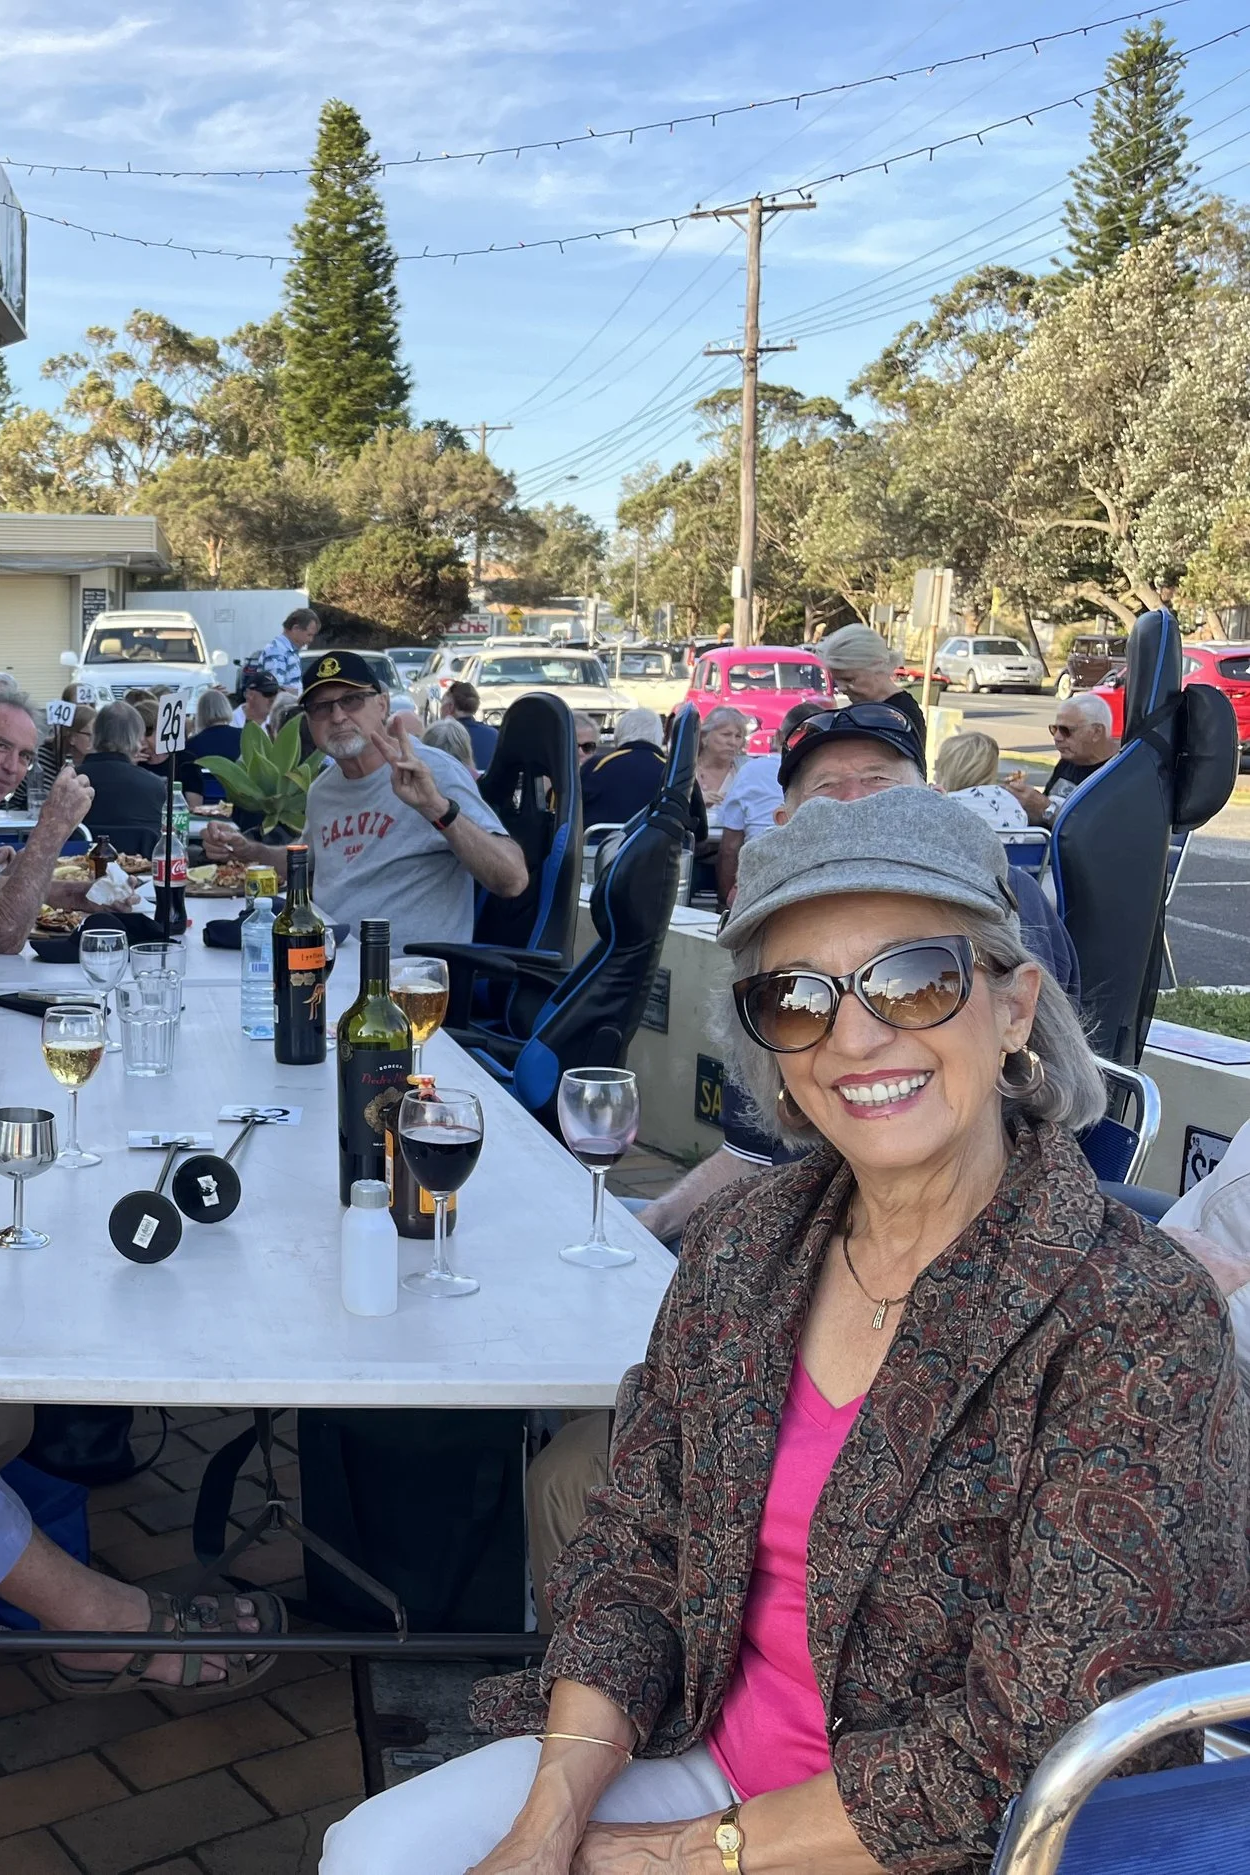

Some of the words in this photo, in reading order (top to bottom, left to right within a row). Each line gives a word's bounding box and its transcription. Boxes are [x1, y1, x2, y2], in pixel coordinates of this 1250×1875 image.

[79, 689, 93, 699] 24
[54, 704, 71, 722] 40
[160, 700, 183, 742] 26
[321, 811, 395, 848] CALVIN
